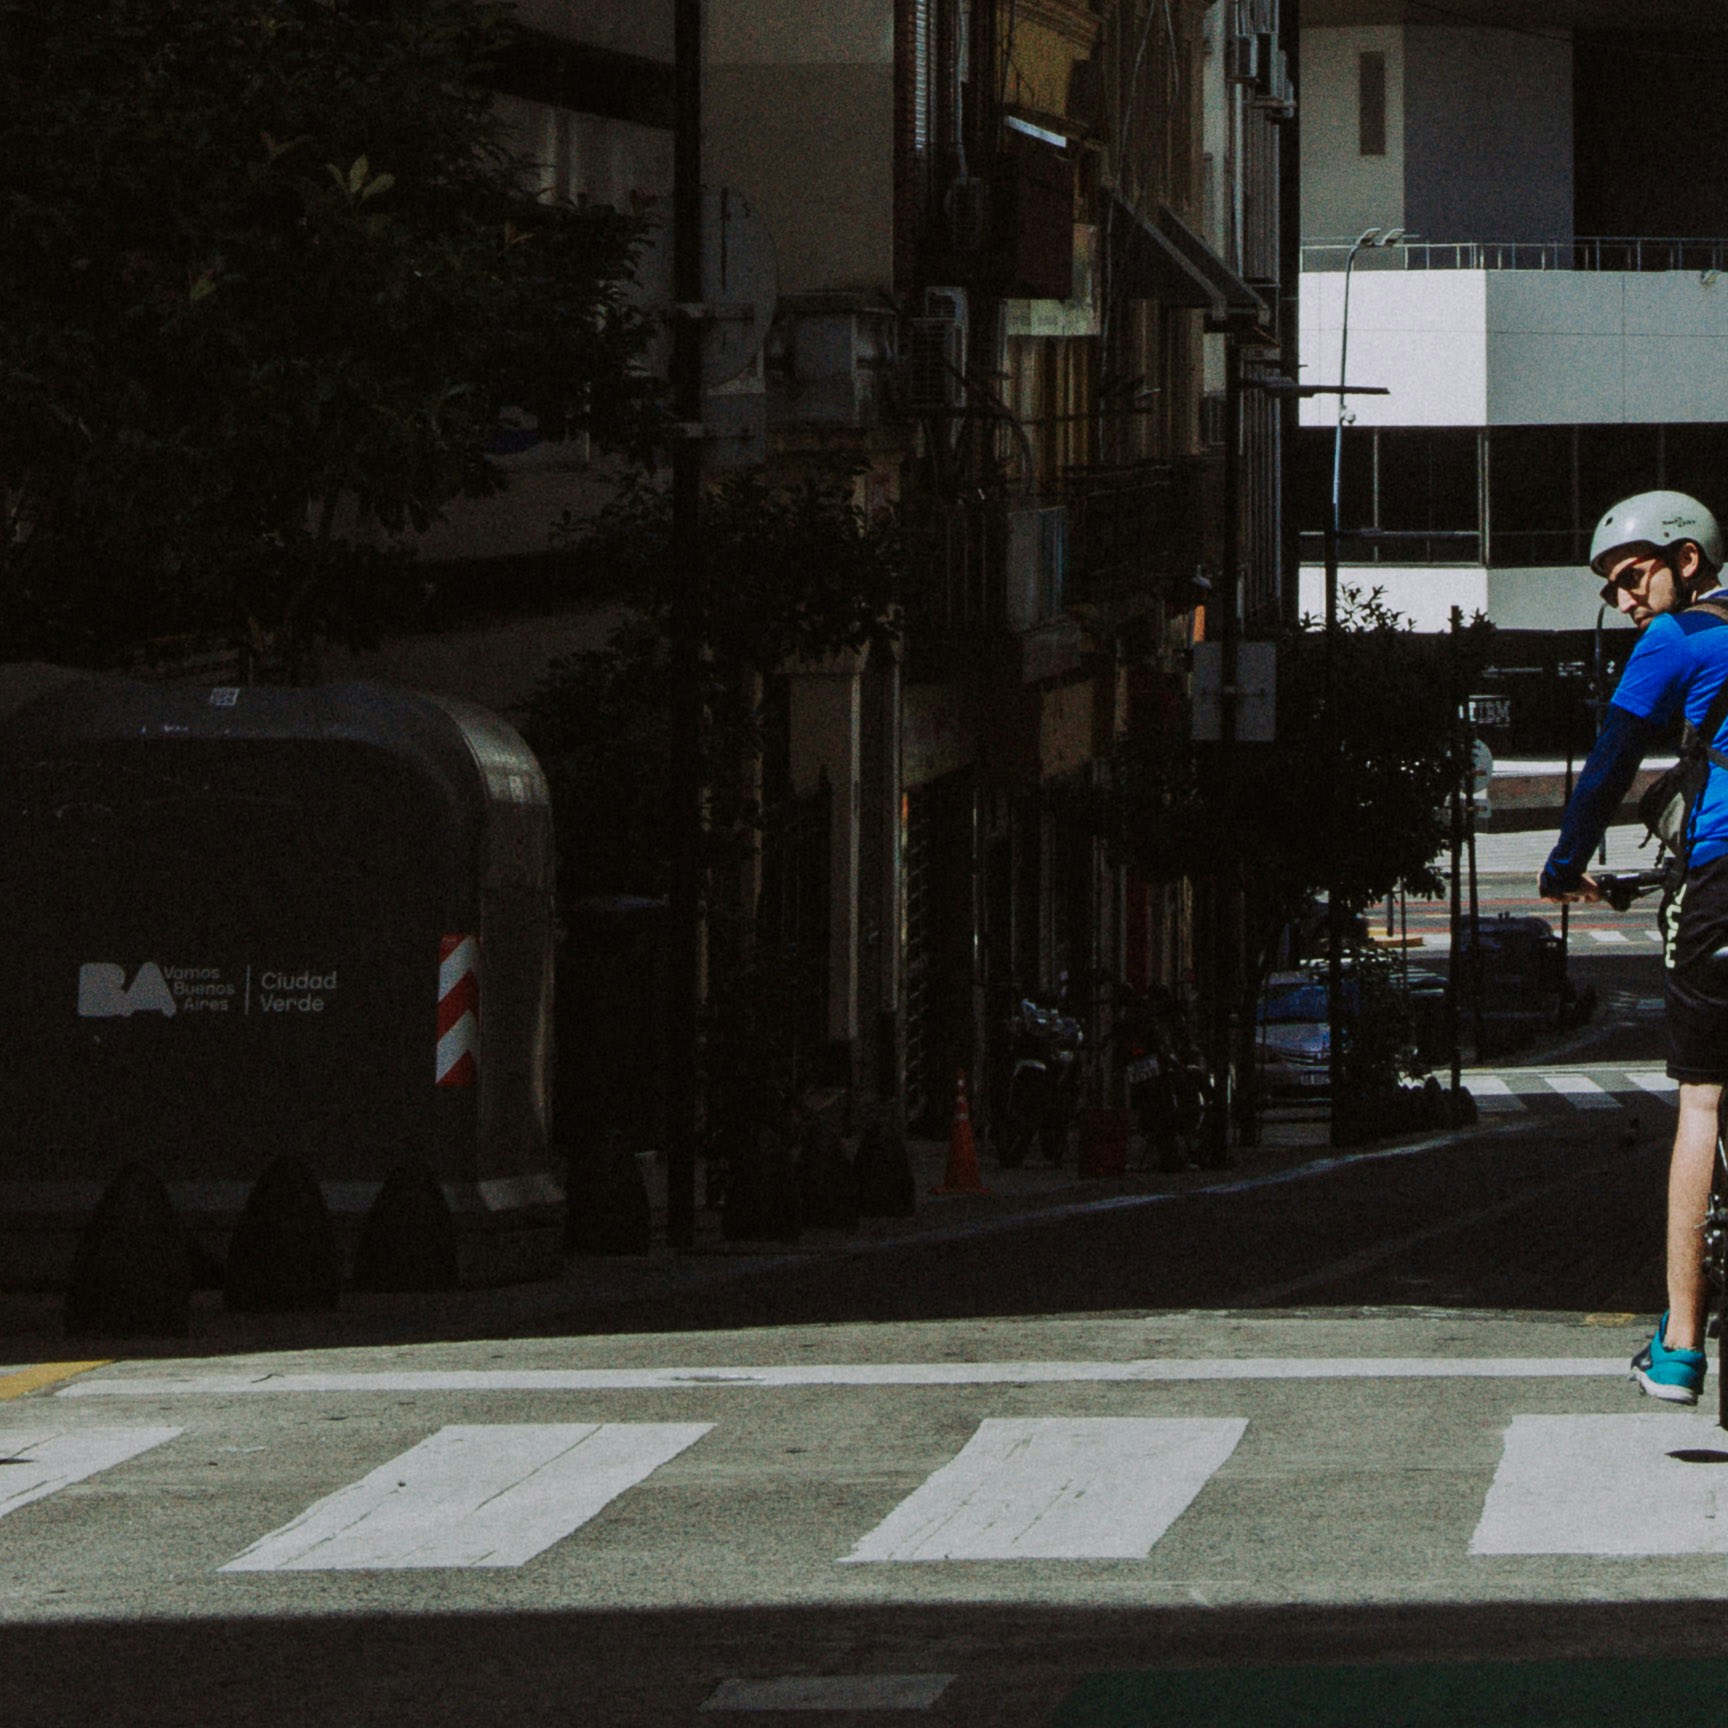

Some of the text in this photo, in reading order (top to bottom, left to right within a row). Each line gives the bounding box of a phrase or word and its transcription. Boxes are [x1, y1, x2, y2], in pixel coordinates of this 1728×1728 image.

[164, 965, 220, 980] Vamos
[261, 970, 337, 991] Ciudad
[78, 961, 177, 1018] BA
[174, 980, 235, 995] Buenos
[184, 997, 229, 1012] Aires
[260, 993, 325, 1013] Verde
